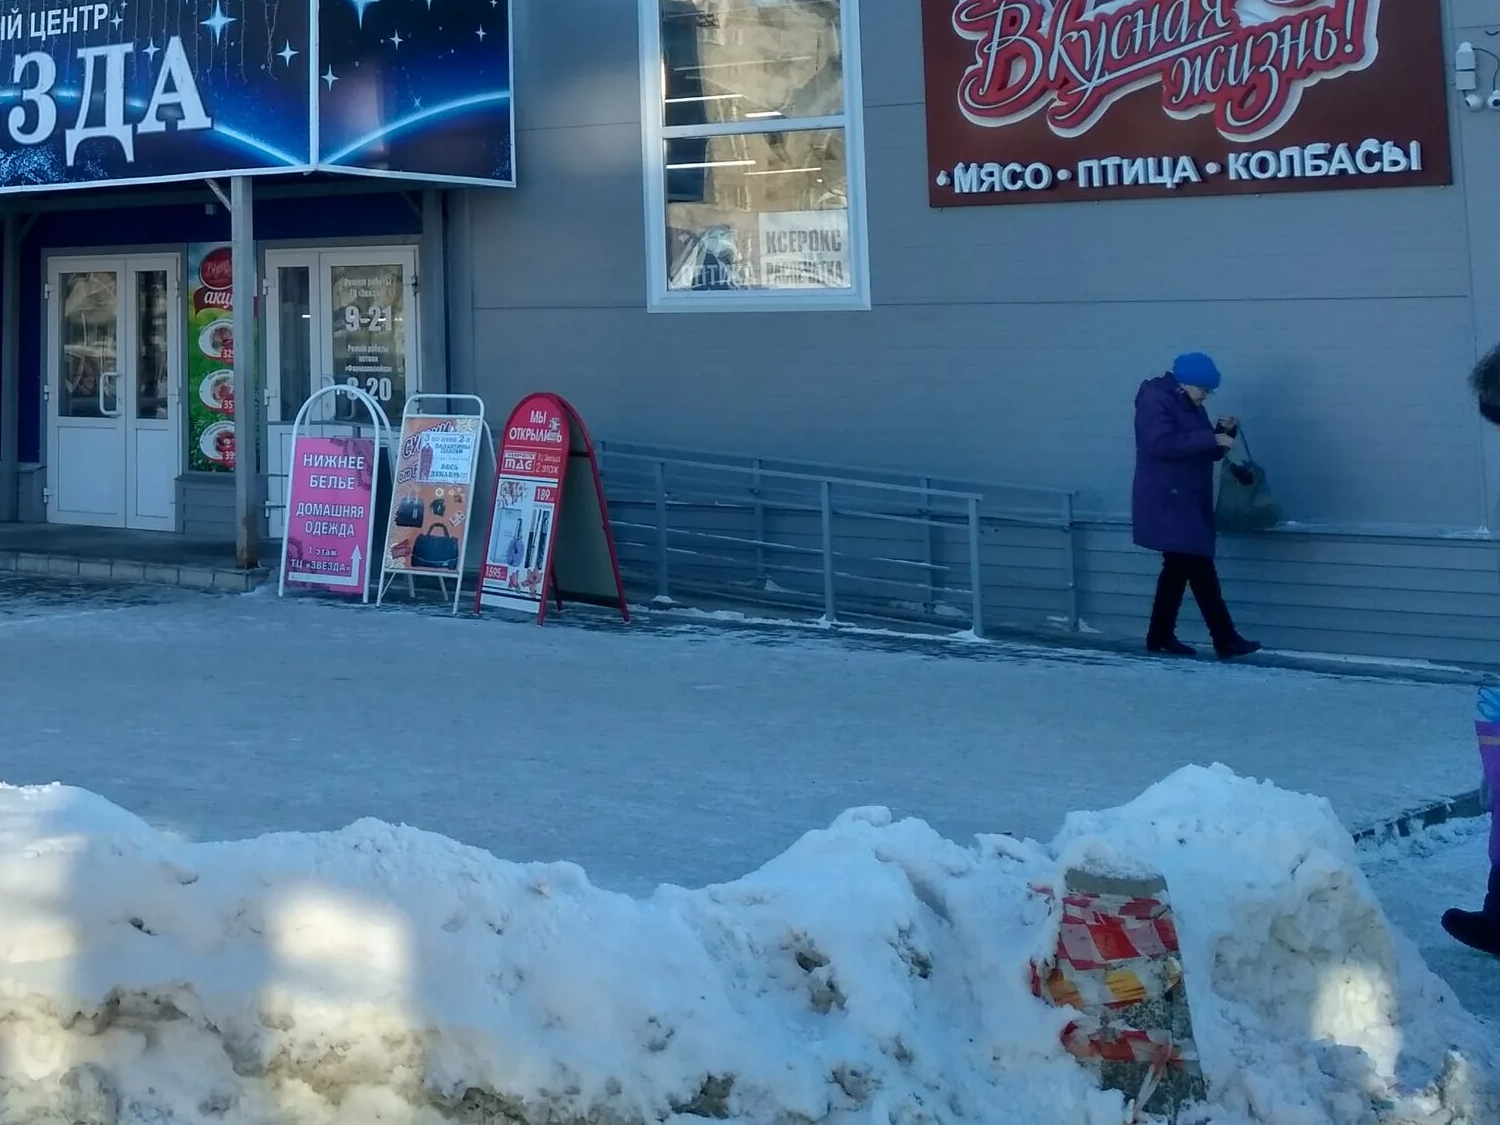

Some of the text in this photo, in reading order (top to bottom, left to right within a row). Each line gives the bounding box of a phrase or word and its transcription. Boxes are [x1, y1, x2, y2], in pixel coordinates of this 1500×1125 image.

[29, 4, 109, 42] ЦЕНТР
[953, 139, 1423, 194] МЯСО ПТИЦА КОЛБАСЫ
[765, 230, 842, 253] КСЕРОКС
[204, 291, 233, 309] акц
[345, 305, 392, 332] 9-21
[530, 410, 547, 424] МЫ
[509, 426, 563, 443] ОТКРЫЛИЬ
[303, 453, 365, 469] НИЖНЕЕ
[309, 475, 355, 490] БЕЛЬЕ
[296, 502, 364, 518] ДОМАШНЯЯ
[305, 520, 355, 537] ОДЕЖДА
[290, 559, 303, 569] ТЦ
